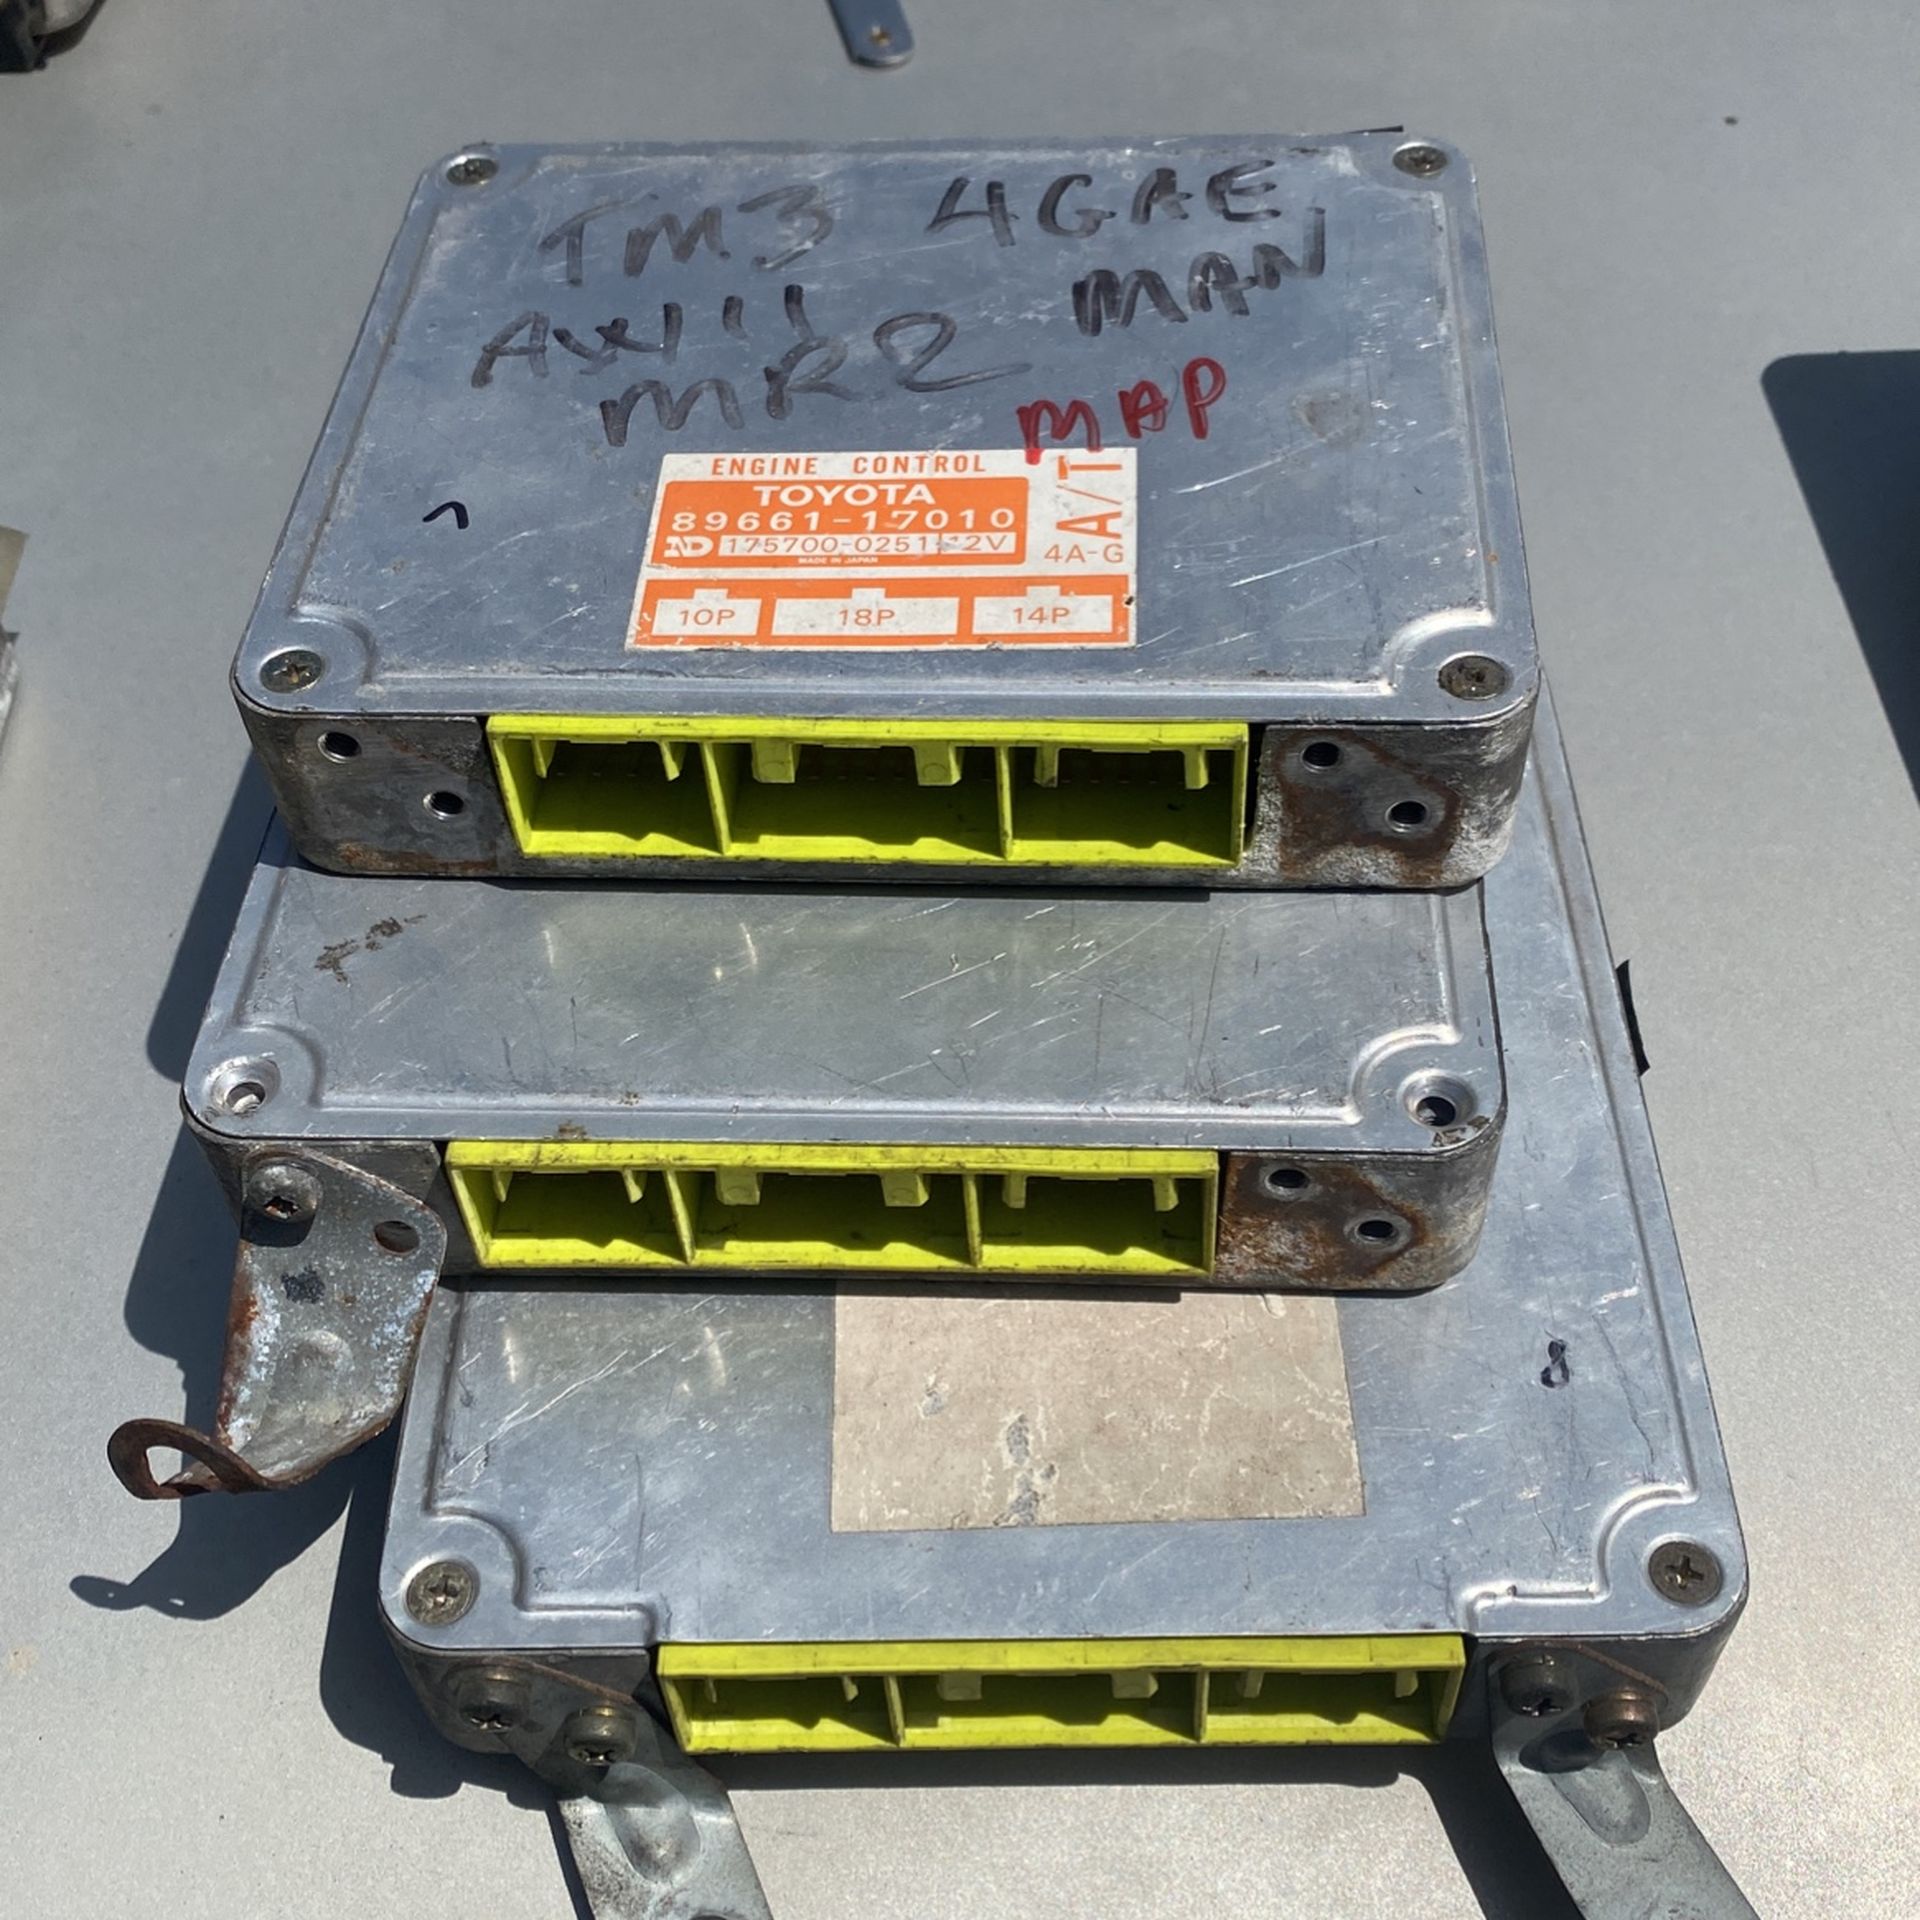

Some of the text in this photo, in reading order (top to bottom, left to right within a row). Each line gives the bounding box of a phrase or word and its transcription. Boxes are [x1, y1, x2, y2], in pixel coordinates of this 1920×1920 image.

[538, 184, 833, 286] TM3
[1071, 206, 1326, 337] MAN
[599, 310, 1032, 447] MR2
[1016, 356, 1227, 466] MAP
[711, 454, 986, 476] ENGINE CONTROL
[752, 483, 936, 507] TOYOTA
[1055, 455, 1123, 540] A/T
[671, 508, 1016, 533] 89661-17010
[727, 534, 929, 554] 175700-0251
[1043, 543, 1125, 564] 4A-G
[798, 554, 879, 565] MADE IN JAPAN
[677, 608, 736, 627] 10P
[838, 607, 896, 627] 18P
[1012, 606, 1070, 626] 14P
